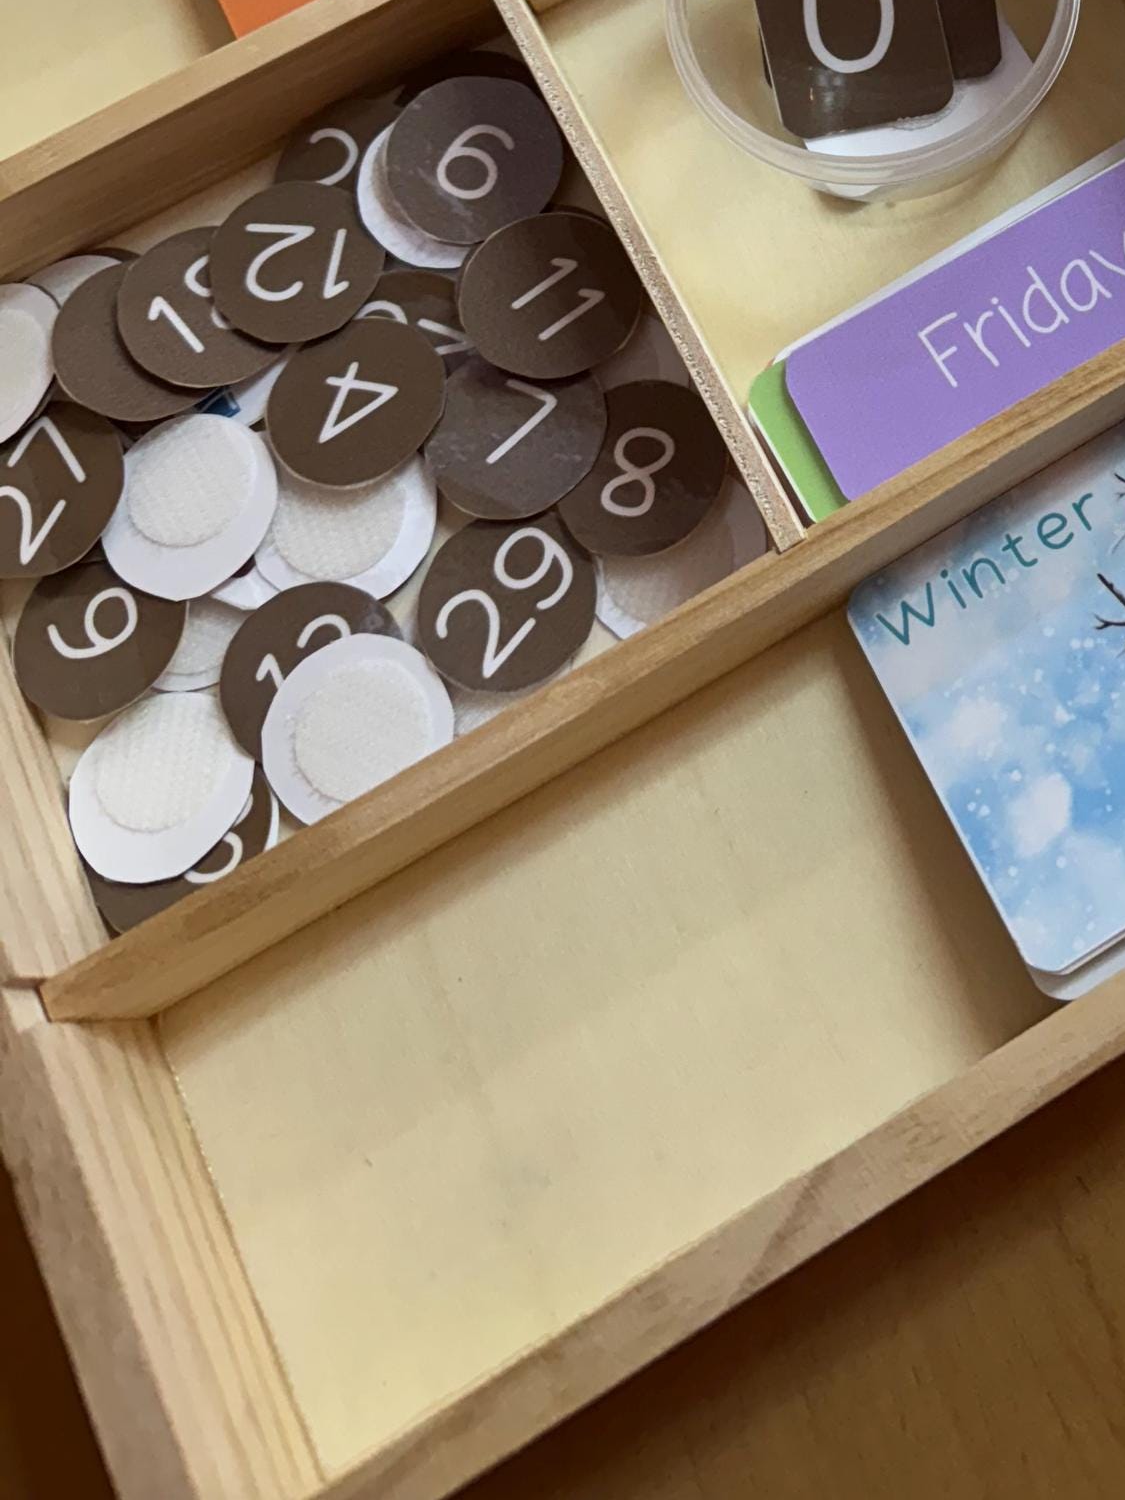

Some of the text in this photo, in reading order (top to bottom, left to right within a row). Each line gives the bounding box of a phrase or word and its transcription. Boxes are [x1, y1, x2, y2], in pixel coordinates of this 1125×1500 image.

[511, 257, 605, 341] 11
[319, 361, 399, 444] 4
[0, 416, 86, 566] 27
[600, 427, 675, 517] 8
[435, 527, 573, 678] 29
[876, 489, 1096, 648] Winter
